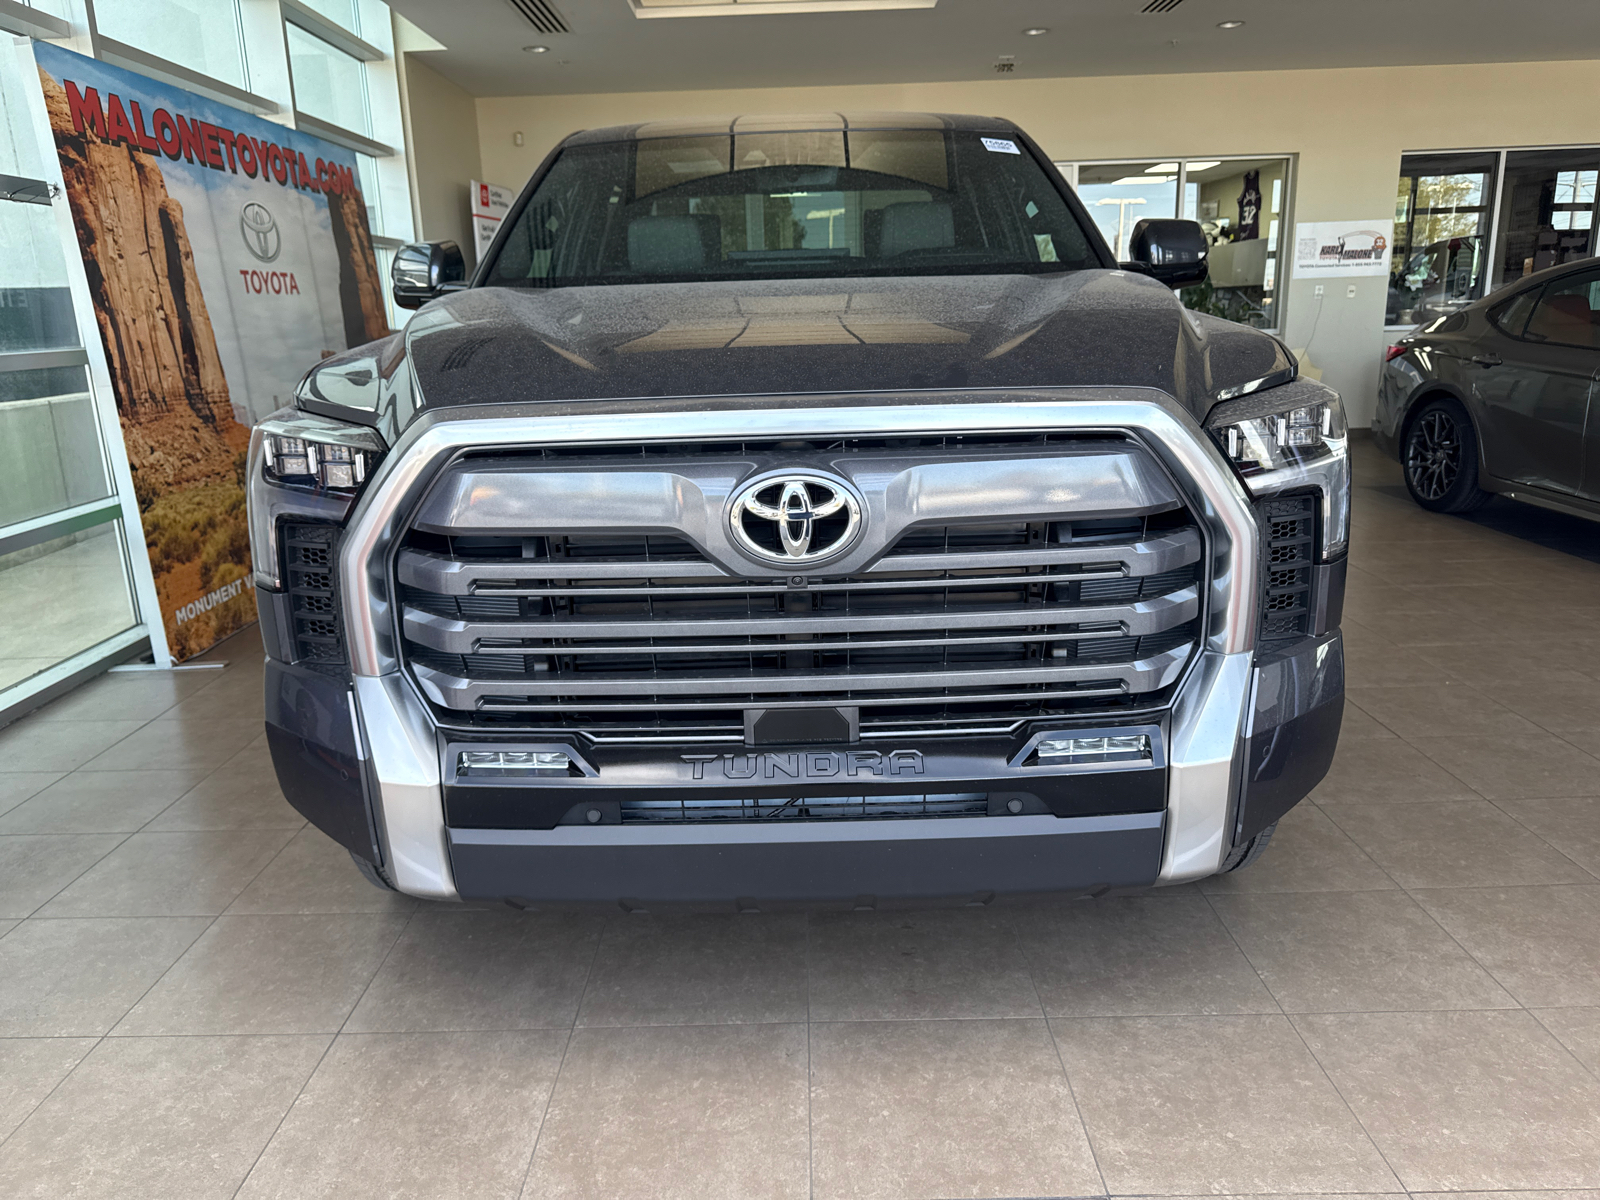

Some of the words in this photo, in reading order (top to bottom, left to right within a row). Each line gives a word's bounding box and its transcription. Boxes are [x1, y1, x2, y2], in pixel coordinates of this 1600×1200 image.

[63, 78, 356, 195] MALONETOYOTA.COM
[1241, 205, 1257, 225] 32
[1320, 245, 1340, 255] KARL
[1342, 249, 1372, 259] MALONE
[239, 269, 300, 295] TOYOTA
[175, 579, 242, 626] MONUMENT
[680, 749, 925, 780] TUNDRA
